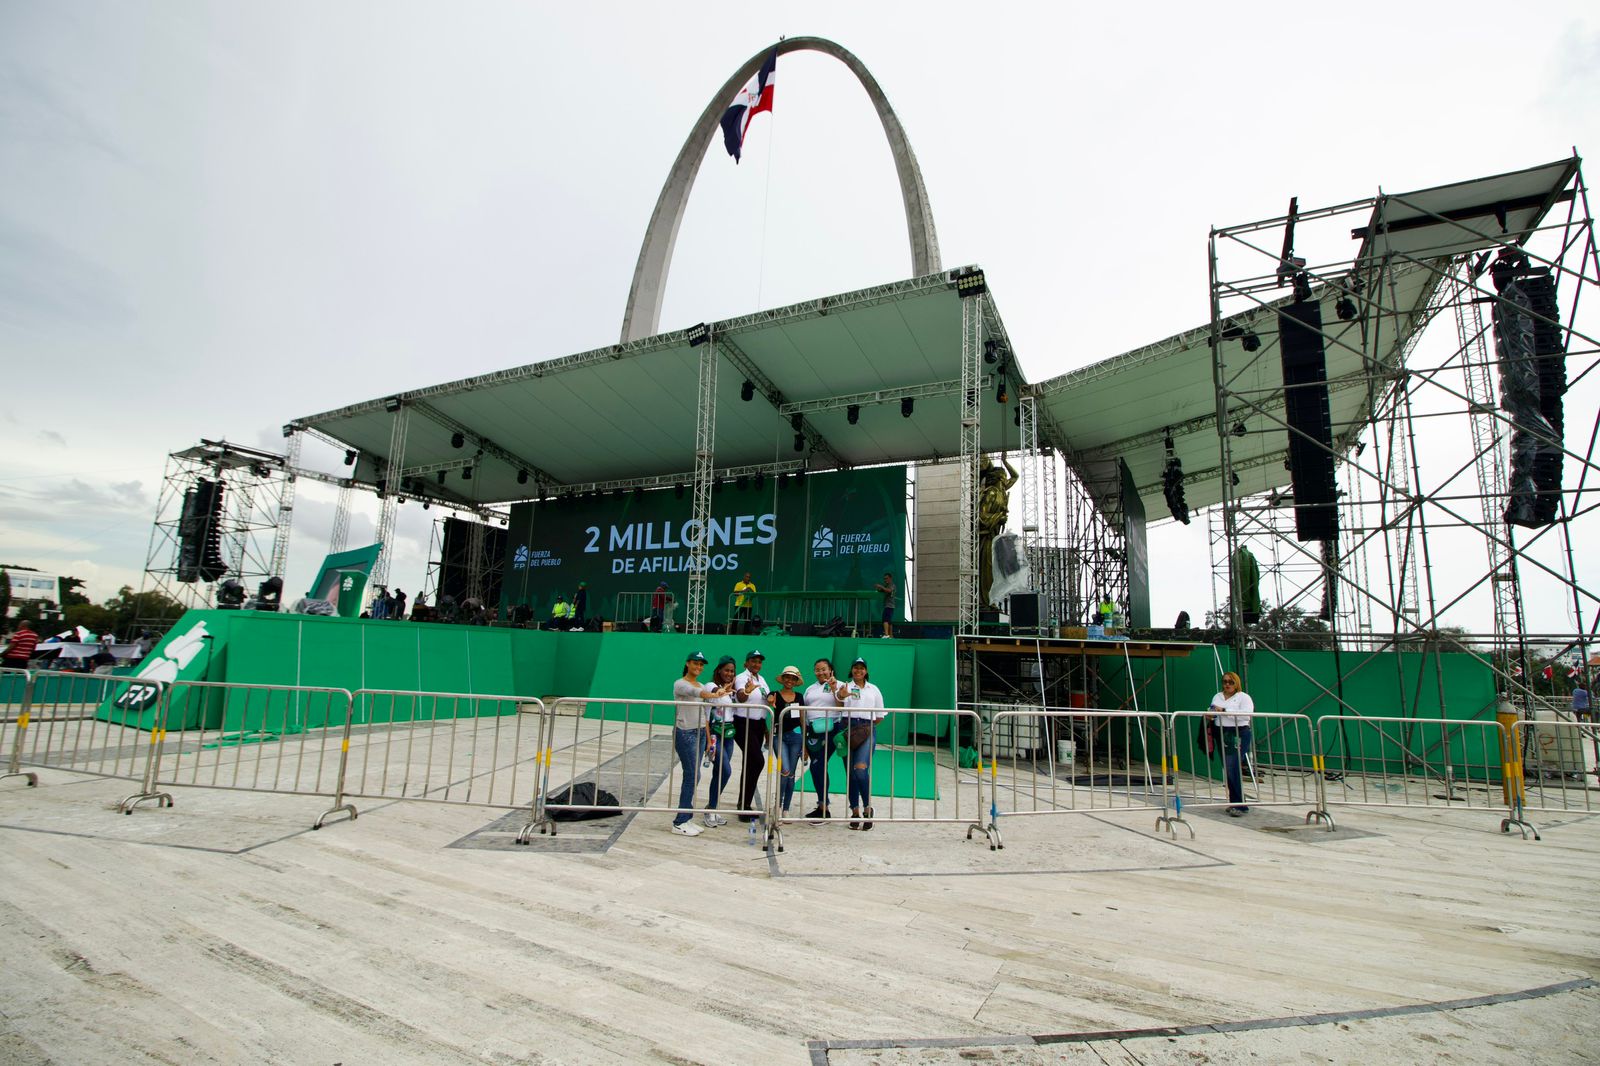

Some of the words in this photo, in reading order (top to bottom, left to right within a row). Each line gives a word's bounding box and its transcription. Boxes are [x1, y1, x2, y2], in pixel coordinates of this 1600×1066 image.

[584, 526, 600, 553] 2
[609, 513, 778, 552] MILLONES
[840, 533, 871, 543] FUERZA
[840, 545, 855, 554] DEL
[857, 543, 890, 554] PUEBLO
[531, 550, 551, 559] FUERZA
[813, 550, 831, 558] FP
[530, 559, 540, 567] DEL
[540, 558, 562, 567] PUEBLO
[612, 558, 635, 574] DE
[639, 553, 739, 573] AFILIADOS
[117, 684, 156, 705] FP
